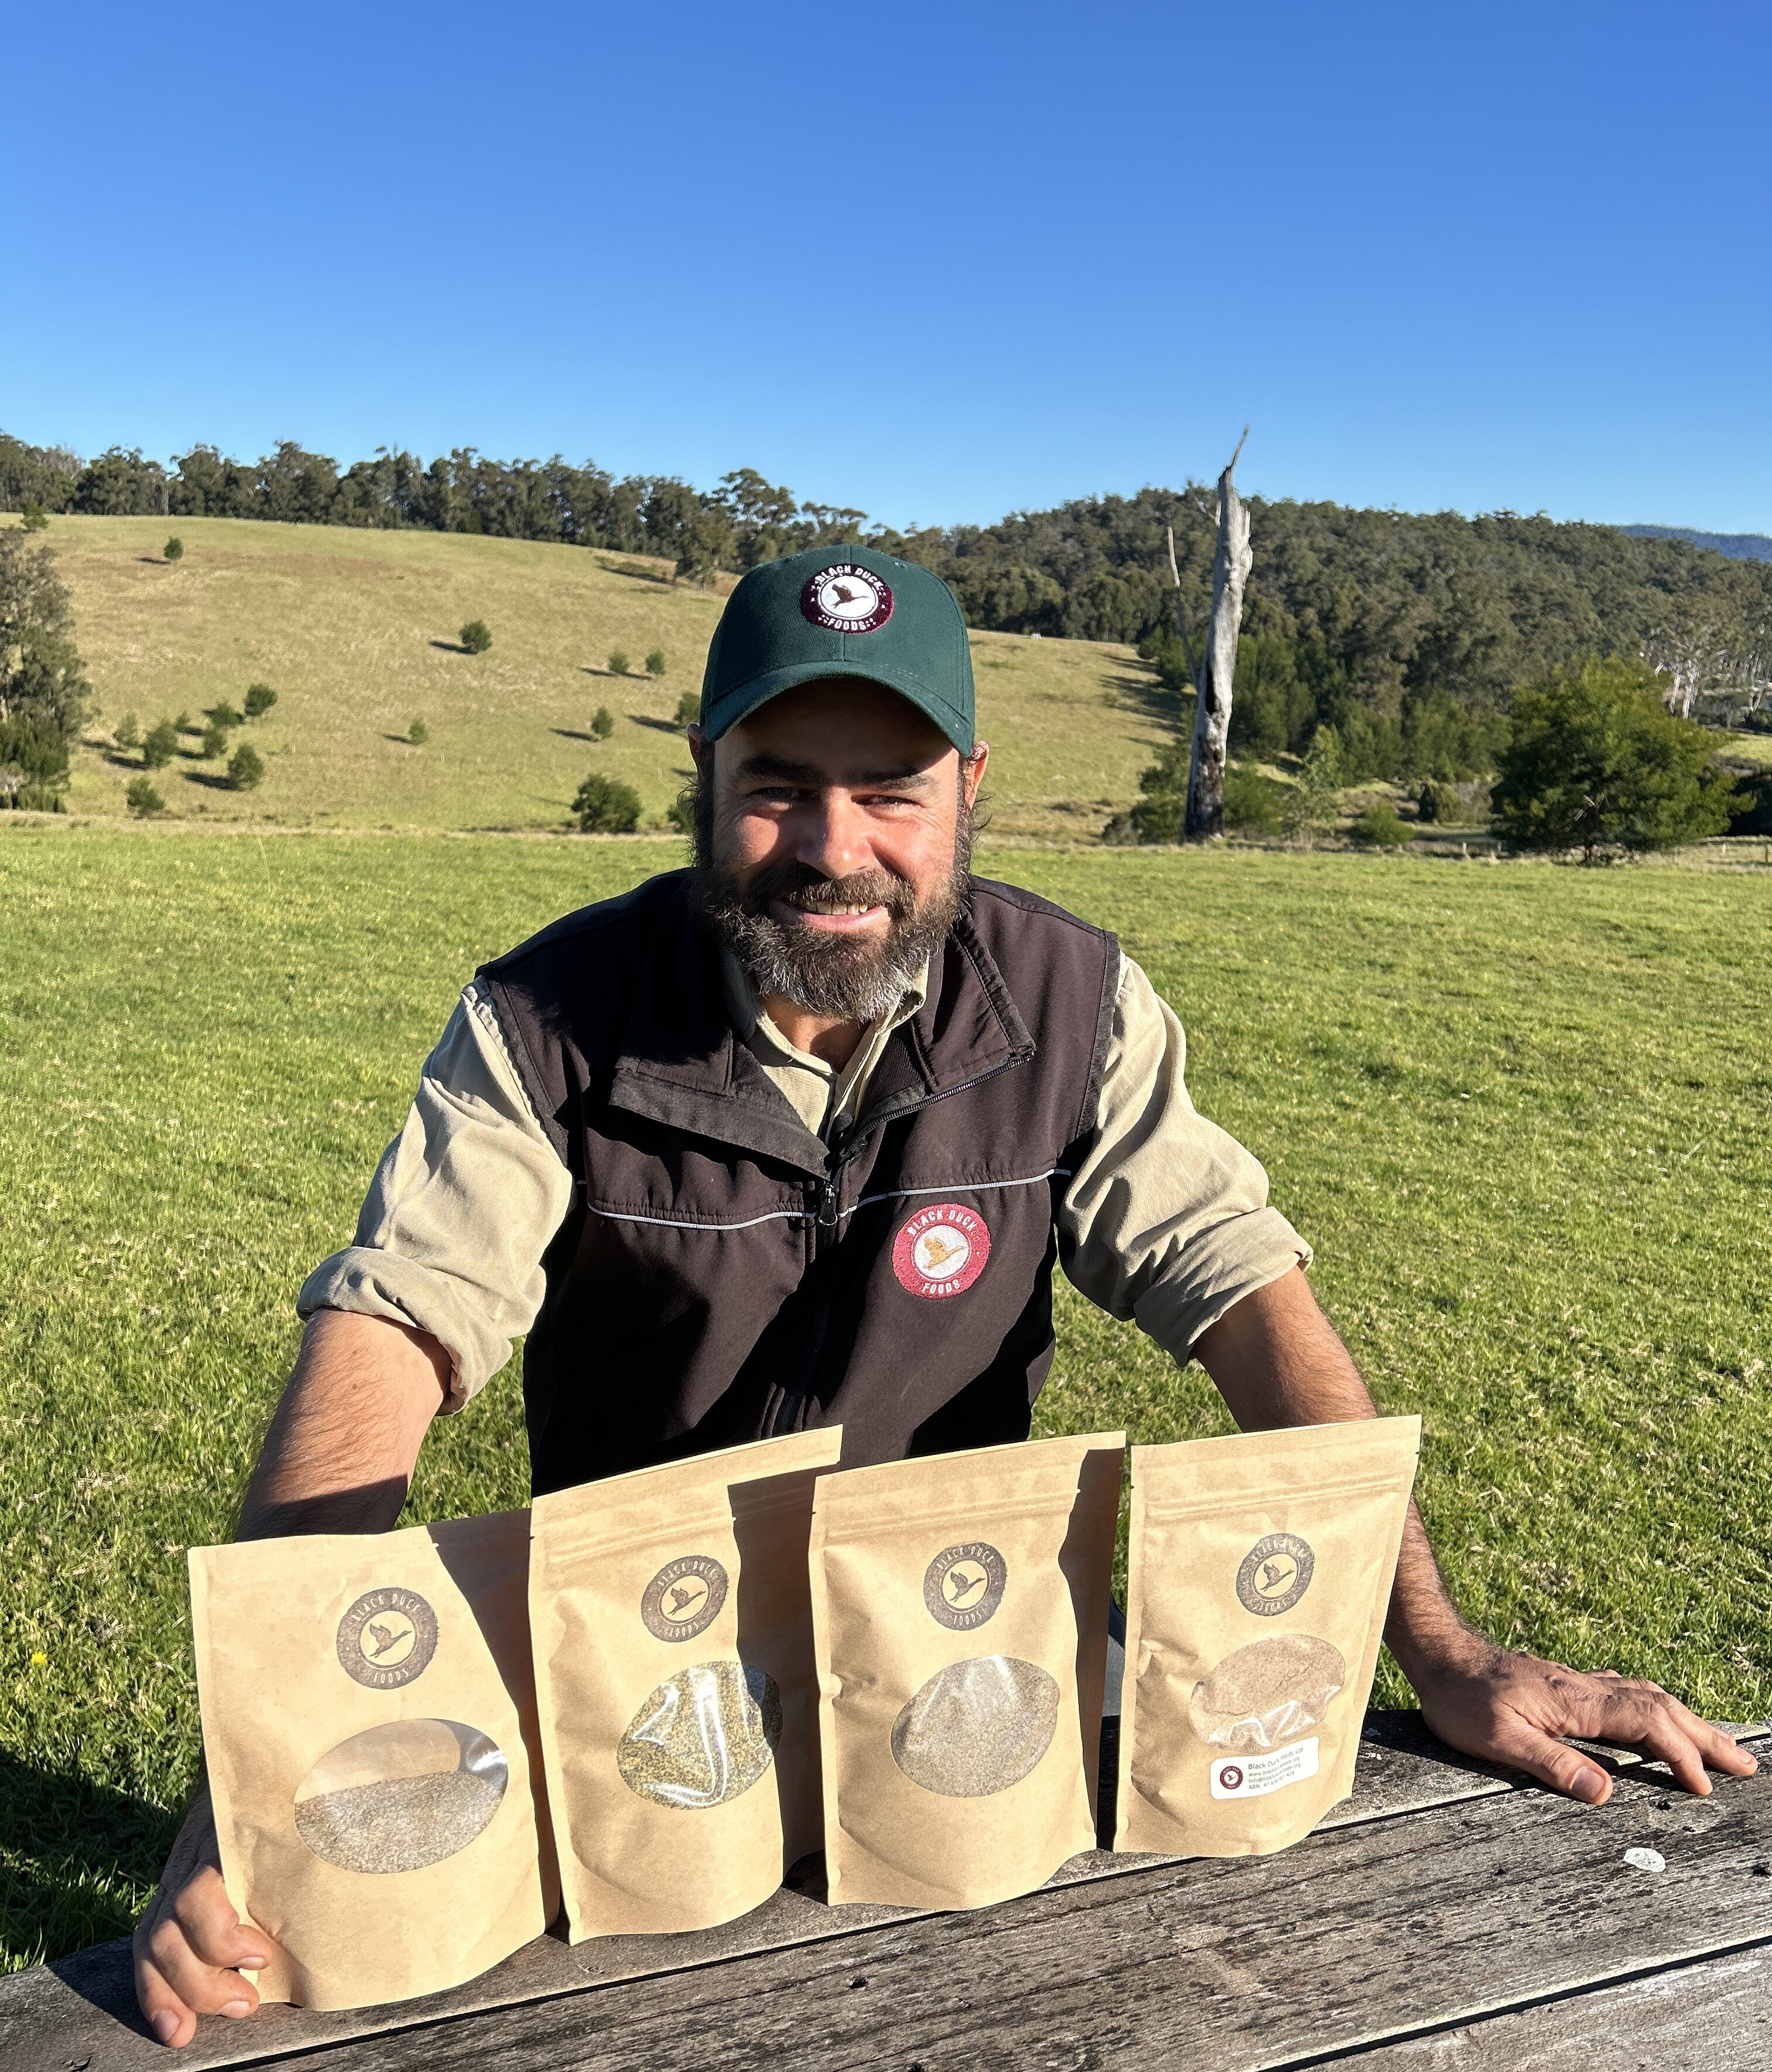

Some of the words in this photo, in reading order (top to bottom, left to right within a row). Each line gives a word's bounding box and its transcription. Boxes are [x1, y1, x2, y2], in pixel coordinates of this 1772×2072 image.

[815, 565, 851, 585] BLACK
[855, 567, 884, 588] DUCK
[827, 618, 867, 630] FOODS
[907, 1209, 943, 1235] BLACK
[948, 1209, 977, 1231] DUCK
[921, 1279, 960, 1294] FOODS
[936, 1546, 965, 1570] BLACK
[970, 1546, 994, 1564] DUCK
[657, 1562, 686, 1586] BLACK
[693, 1560, 717, 1577] DUCK
[351, 1594, 385, 1621] BLACK
[391, 1593, 421, 1614] DUCK
[670, 1621, 699, 1638] FOODS
[1268, 1758, 1280, 1767] Duck
[1280, 1751, 1294, 1760] Foods
[1295, 1746, 1304, 1754] Ltd
